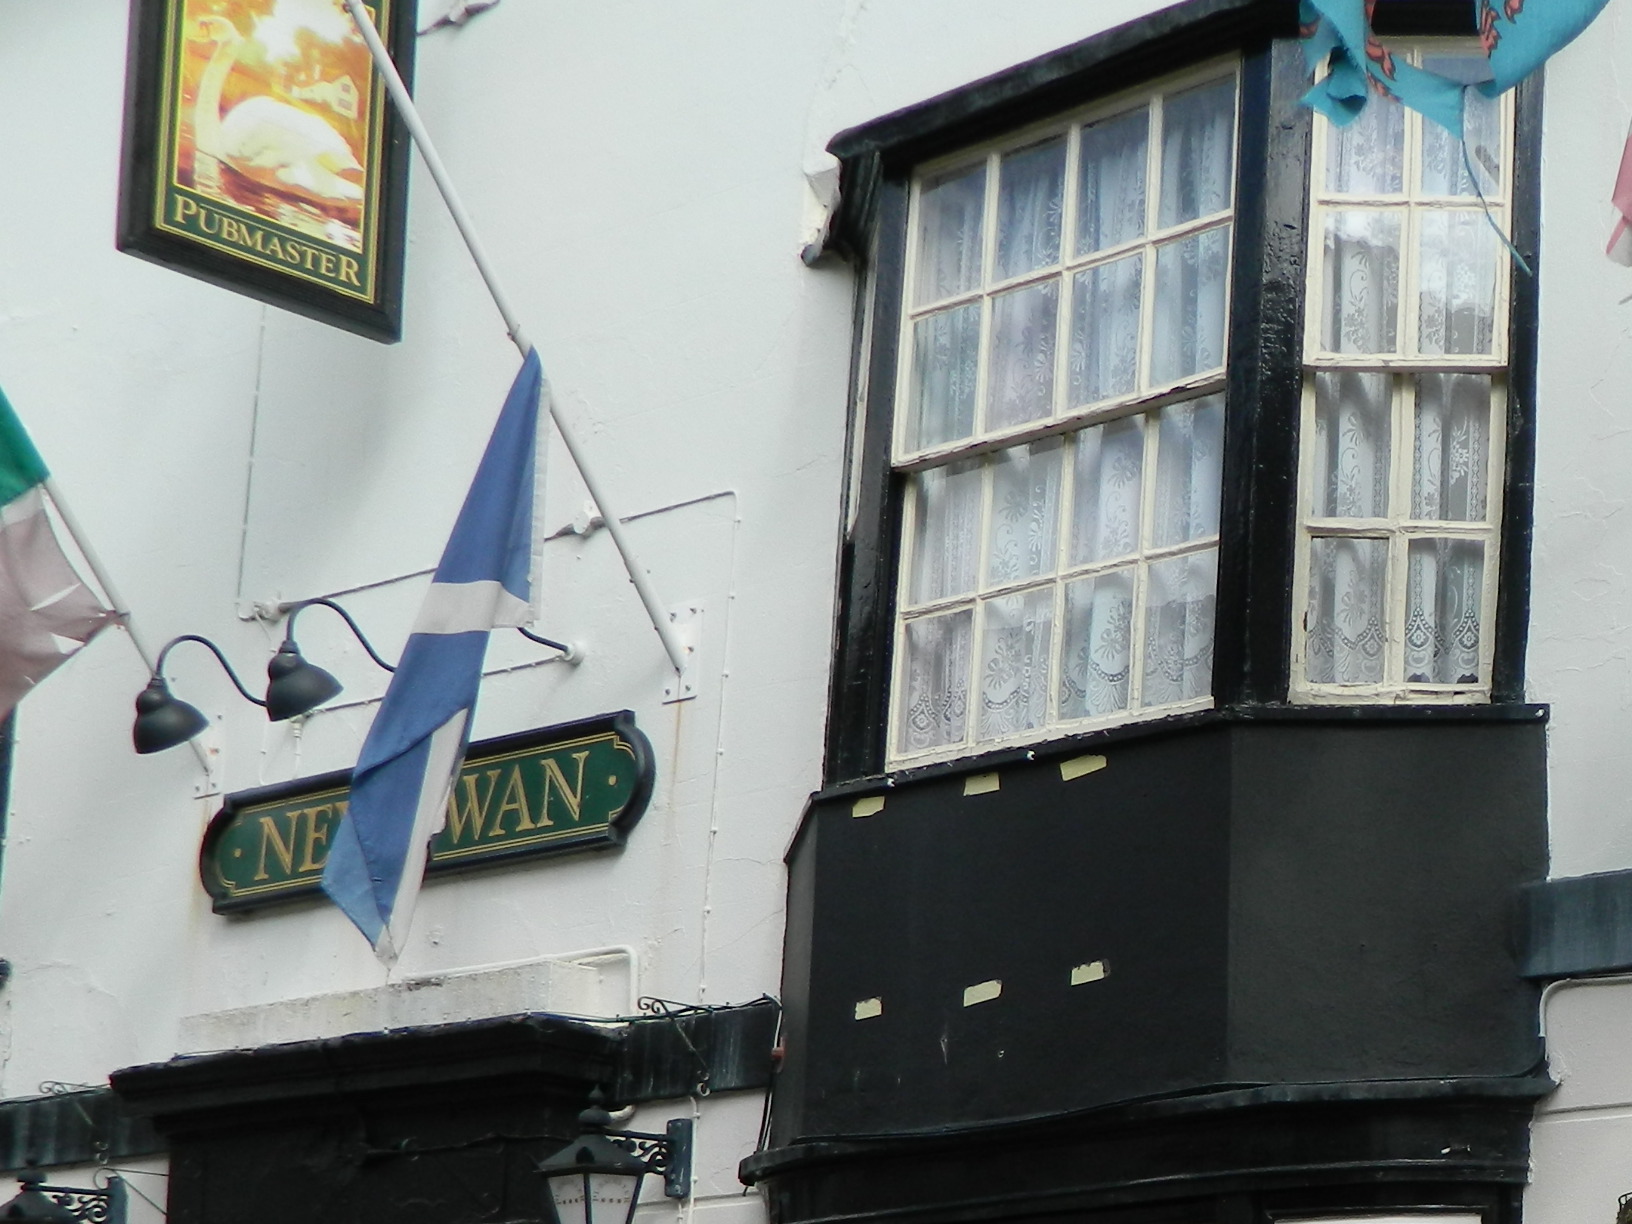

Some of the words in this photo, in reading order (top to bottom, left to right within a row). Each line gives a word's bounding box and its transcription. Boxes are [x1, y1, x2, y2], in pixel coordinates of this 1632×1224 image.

[174, 193, 361, 287] PUBMASTER
[254, 801, 350, 881] NE
[444, 750, 590, 845] WAN
